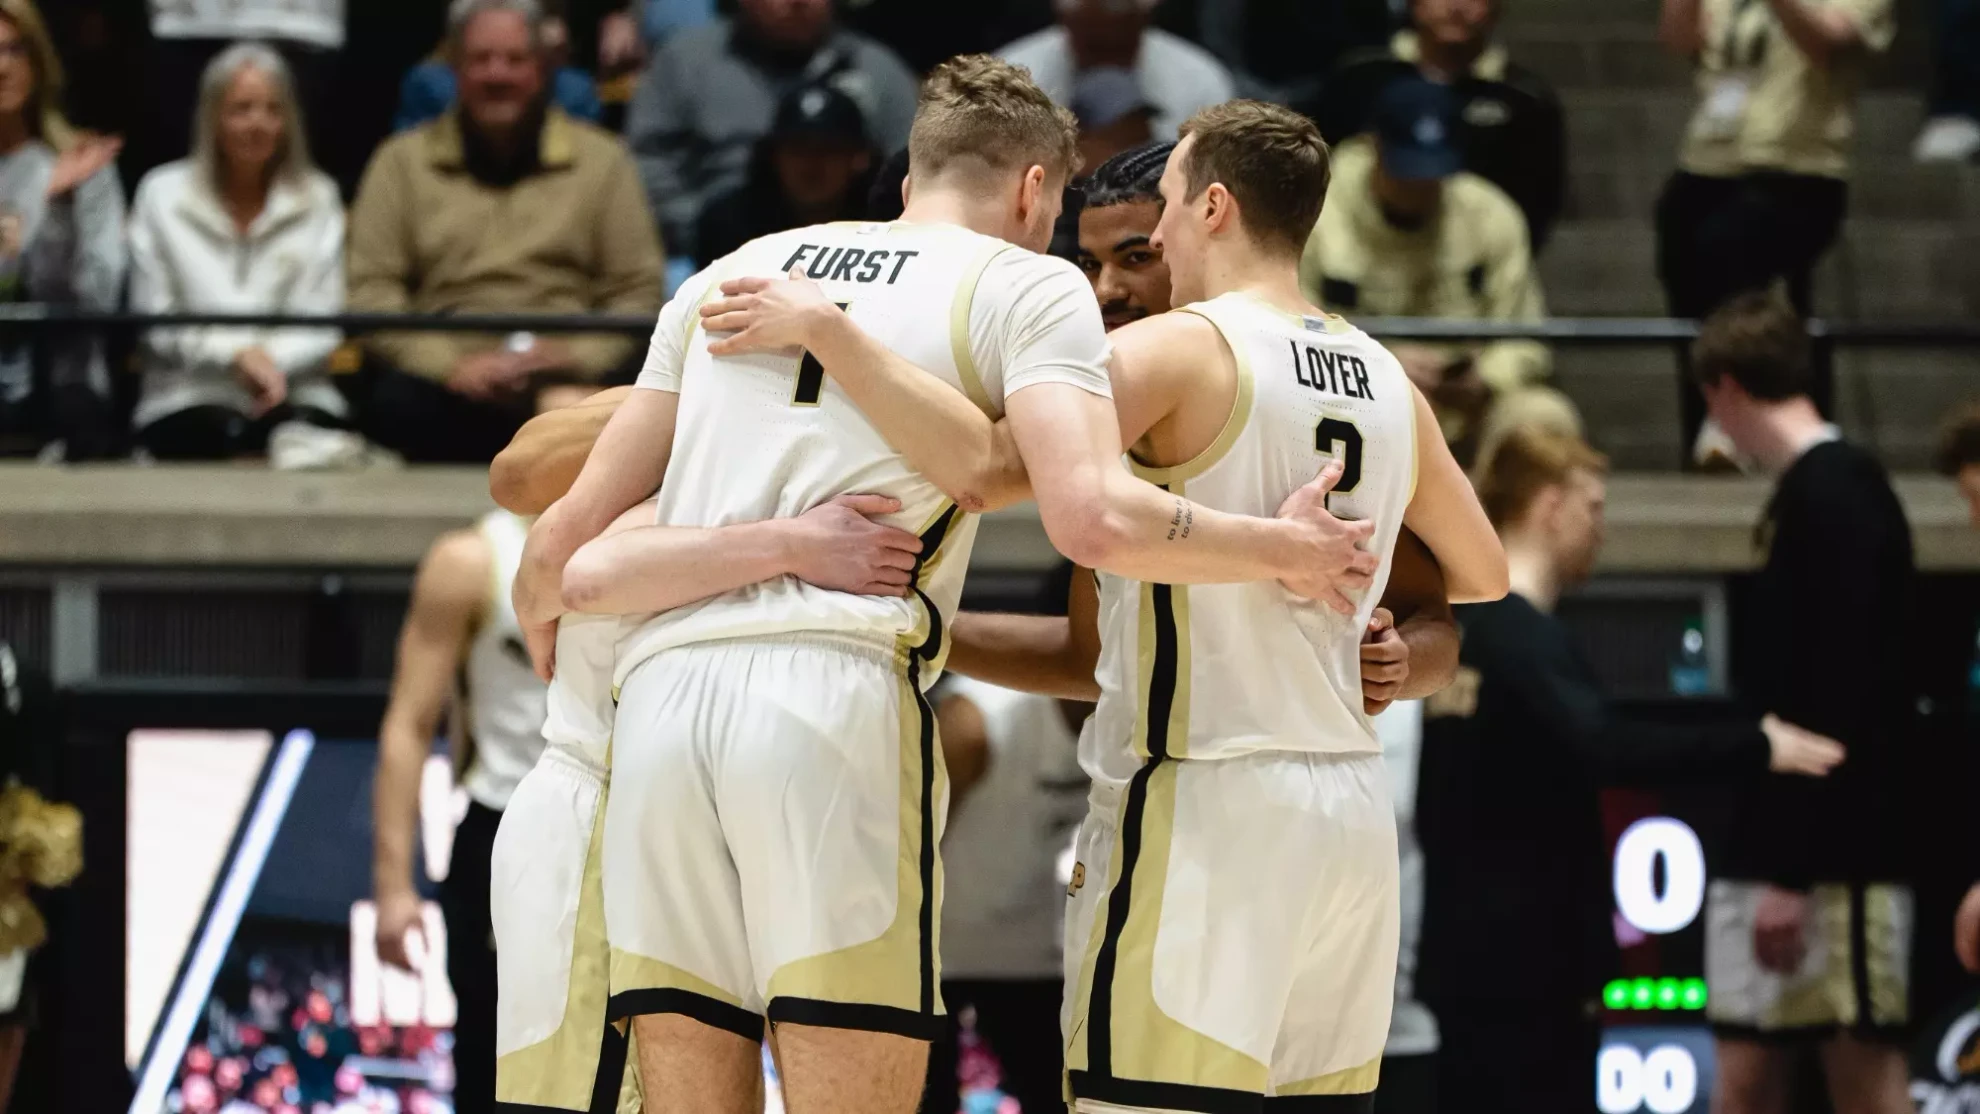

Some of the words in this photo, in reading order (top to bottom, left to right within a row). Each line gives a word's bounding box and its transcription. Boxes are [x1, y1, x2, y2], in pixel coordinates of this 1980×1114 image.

[781, 243, 919, 285] FURST
[1290, 339, 1375, 401] LOYER
[1612, 815, 1706, 934] 0
